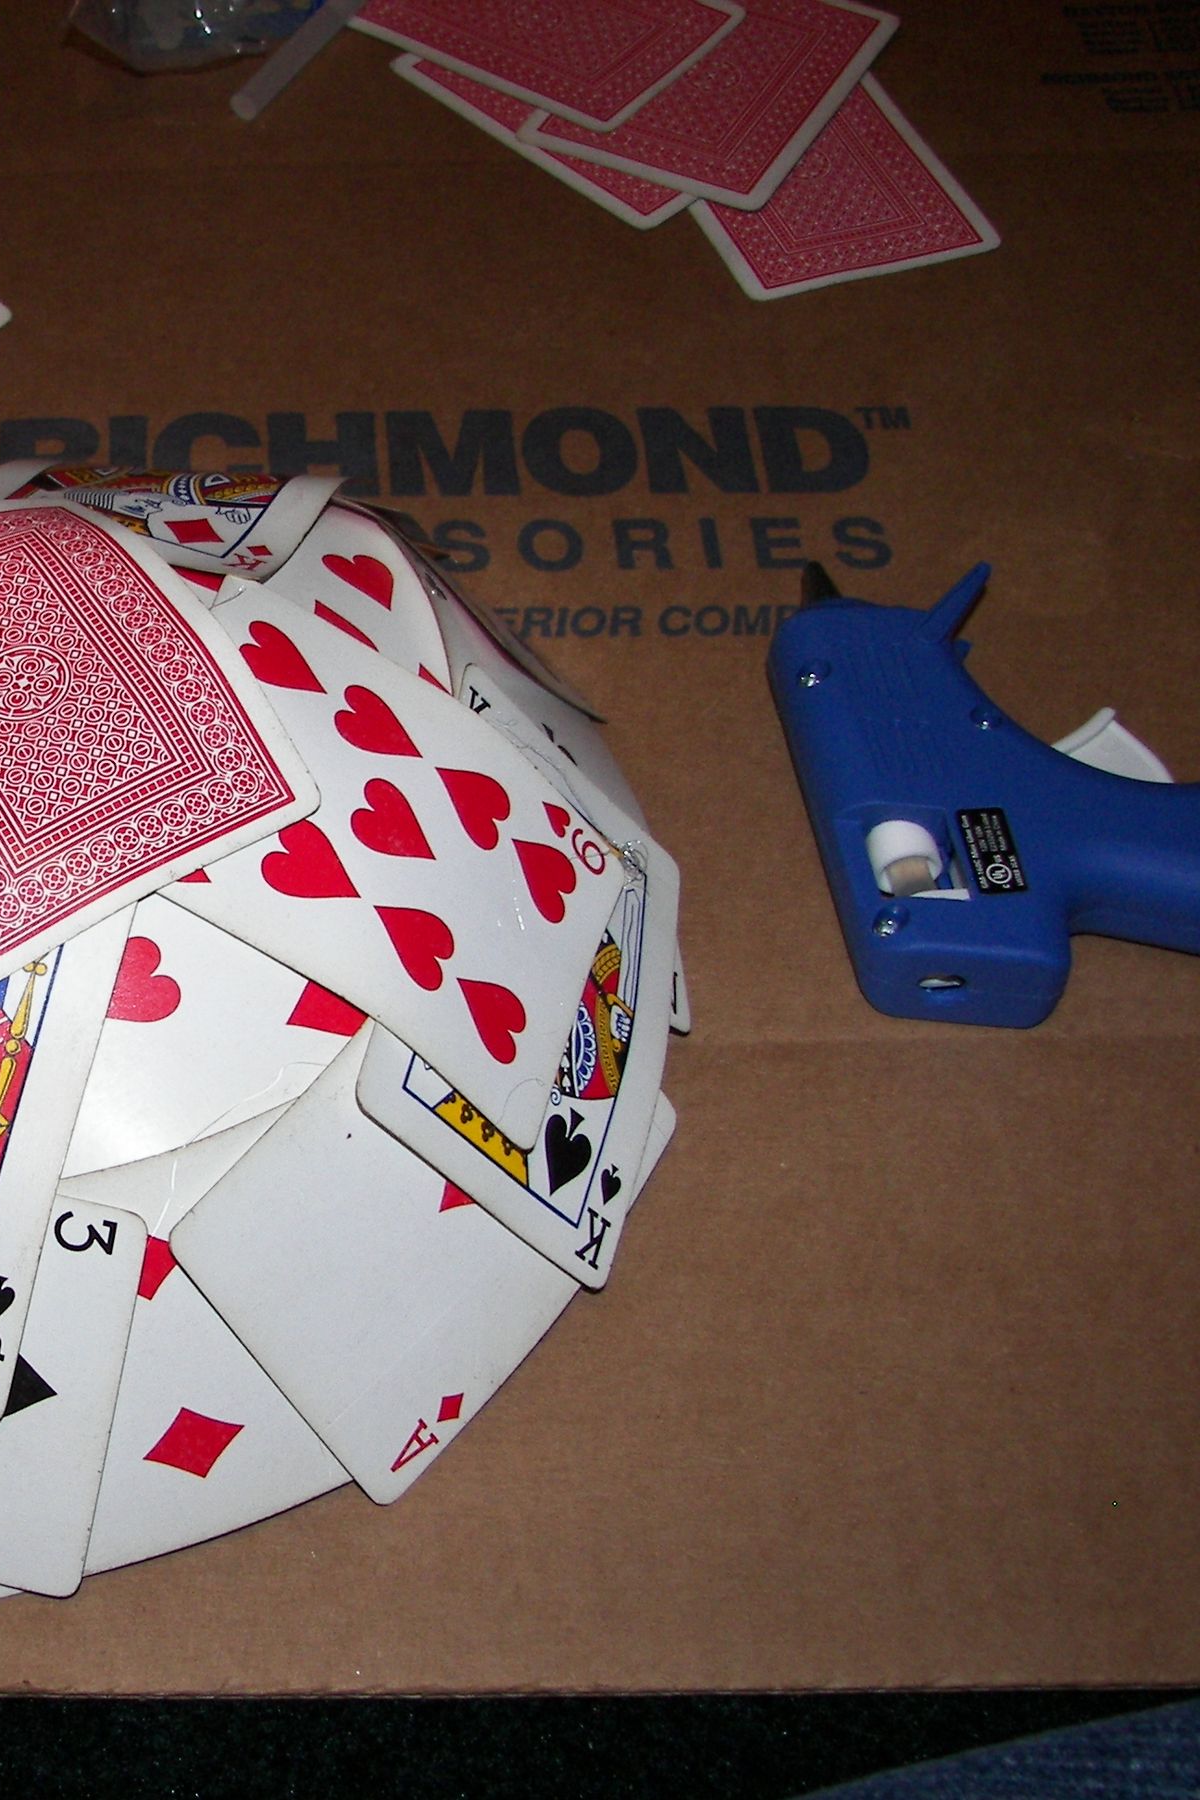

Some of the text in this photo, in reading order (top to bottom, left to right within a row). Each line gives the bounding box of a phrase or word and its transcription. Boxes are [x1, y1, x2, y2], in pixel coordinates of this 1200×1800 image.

[657, 604, 802, 638] COMP
[54, 1210, 119, 1256] 3
[574, 1206, 612, 1270] K
[390, 1417, 440, 1473] A
